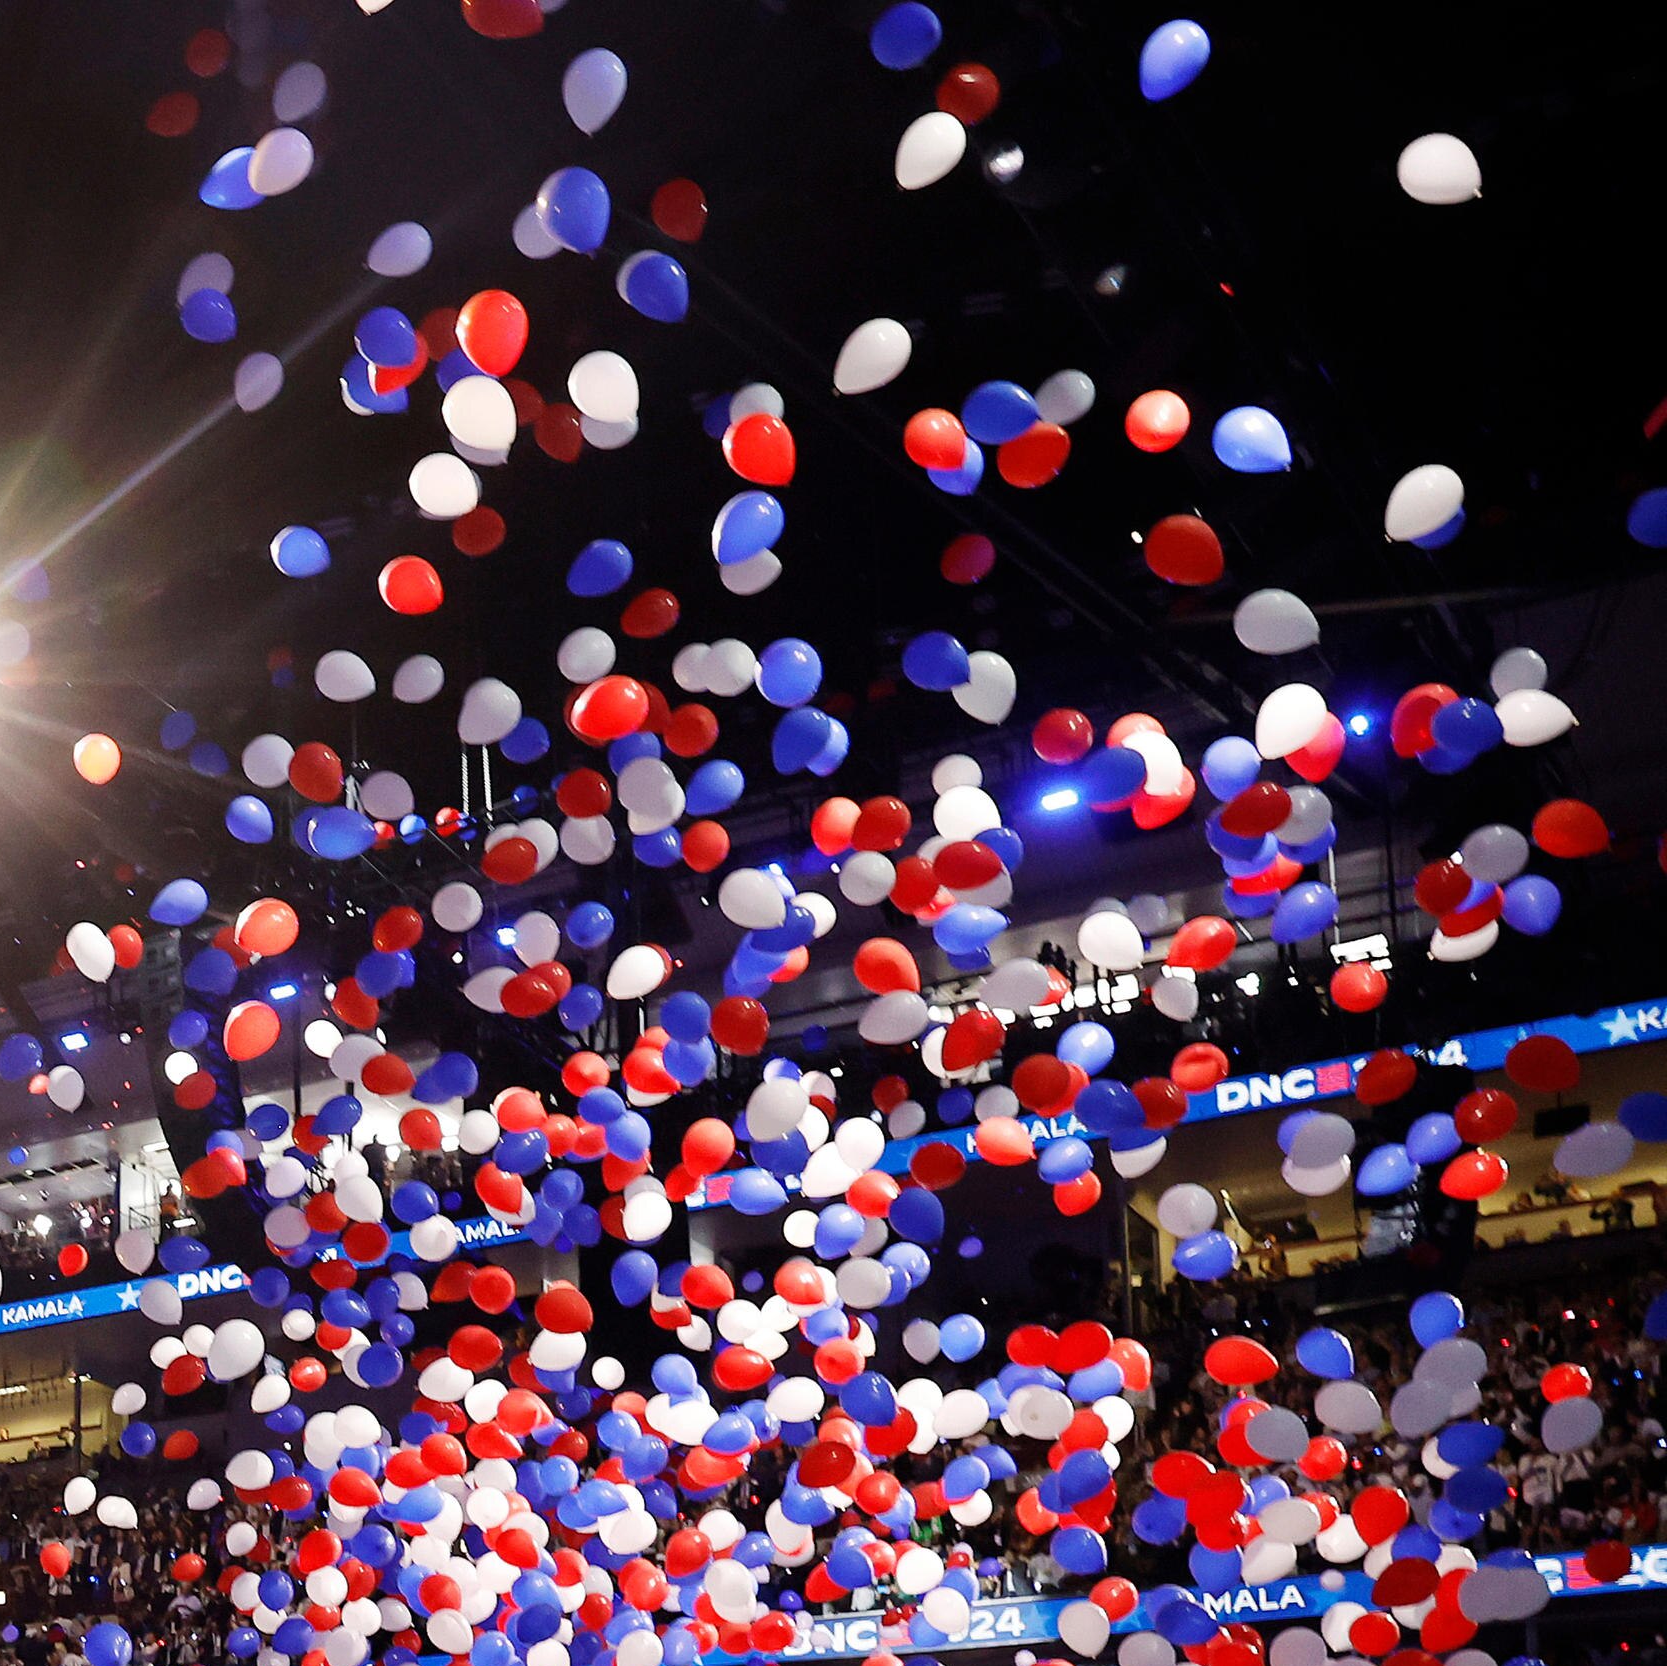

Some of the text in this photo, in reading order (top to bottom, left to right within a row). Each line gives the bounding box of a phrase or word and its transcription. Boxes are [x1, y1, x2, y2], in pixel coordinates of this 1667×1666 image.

[1217, 1075, 1316, 1114] DNC
[453, 1220, 522, 1245] AMAL
[177, 1263, 245, 1300] DNC
[2, 1295, 84, 1326] KAMALA
[1201, 1583, 1306, 1617] MALA
[947, 1605, 1026, 1643] 24
